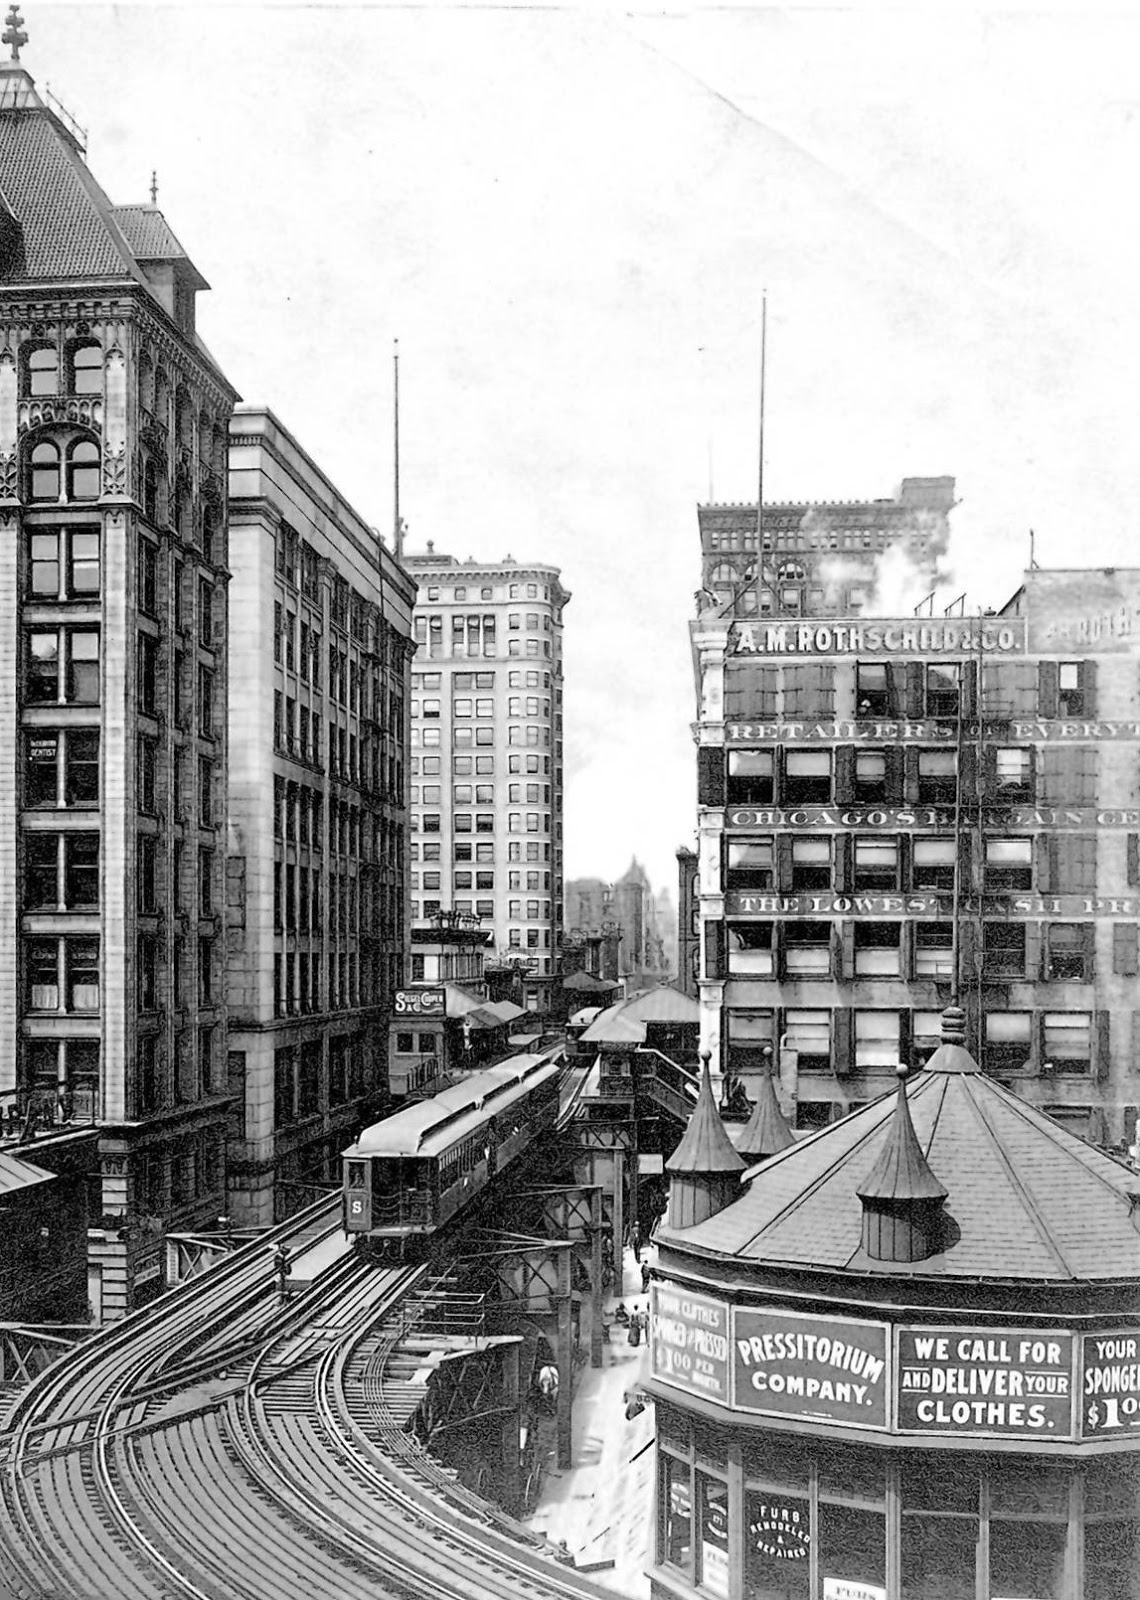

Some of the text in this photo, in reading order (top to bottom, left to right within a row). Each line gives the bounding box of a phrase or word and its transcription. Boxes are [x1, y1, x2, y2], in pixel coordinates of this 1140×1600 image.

[729, 724, 953, 739] RETAILERS
[732, 811, 915, 825] CHICAGO'S
[740, 897, 799, 912] THE
[810, 897, 944, 912] LOWEST
[352, 1200, 362, 1214] S
[737, 1333, 885, 1384] PRESSITORIUM
[914, 1337, 1062, 1364] WE CALL FOR
[1096, 1339, 1137, 1360] YOUR
[752, 1371, 873, 1406] COMPANY.
[902, 1367, 1070, 1397] AND DELIVER YOUR
[917, 1399, 1055, 1428] CLOTHES.
[760, 1505, 800, 1523] FURS
[750, 1521, 811, 1544] REMODELED
[756, 1540, 806, 1559] REPAIRED
